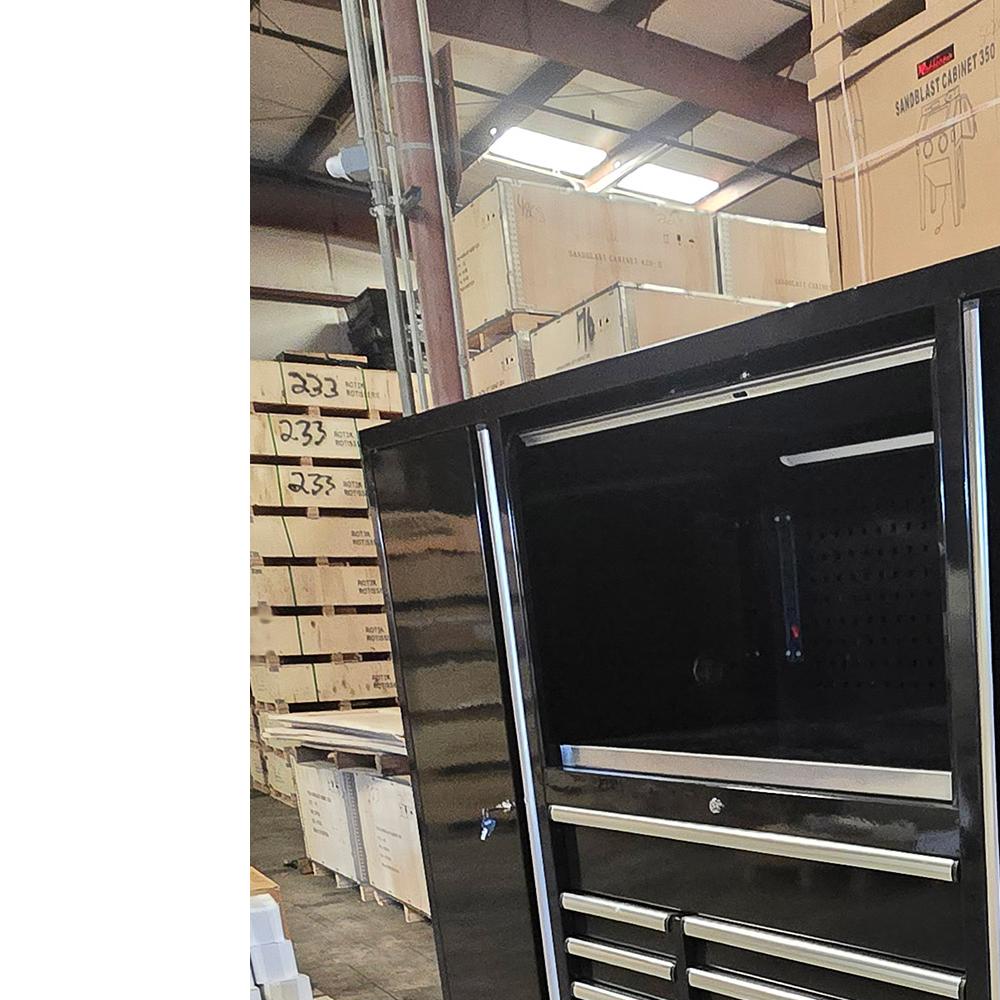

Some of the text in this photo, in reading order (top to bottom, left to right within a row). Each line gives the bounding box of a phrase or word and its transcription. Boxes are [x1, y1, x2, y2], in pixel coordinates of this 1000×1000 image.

[895, 42, 996, 117] SANDBLAST CABINET 350
